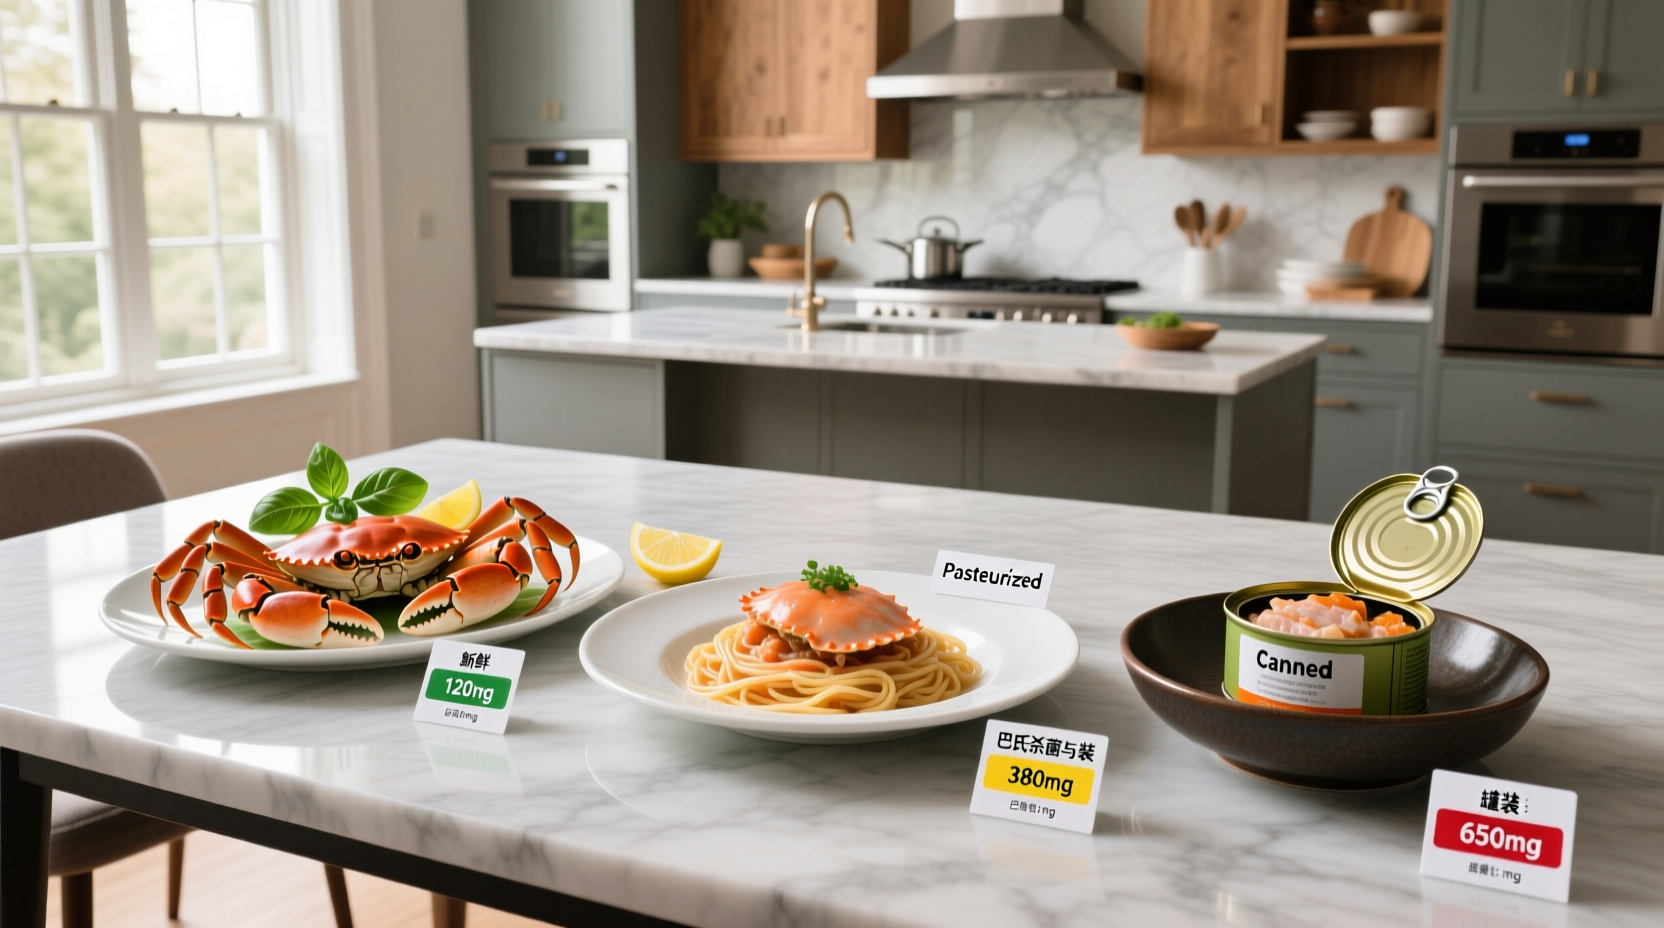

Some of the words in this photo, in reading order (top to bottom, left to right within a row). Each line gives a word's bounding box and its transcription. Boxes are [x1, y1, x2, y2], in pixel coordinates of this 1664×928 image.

[942, 562, 1043, 589] Pasteurized
[1256, 649, 1333, 679] Canned
[1008, 765, 1074, 798] 380mg
[1459, 821, 1542, 861] 650mg
